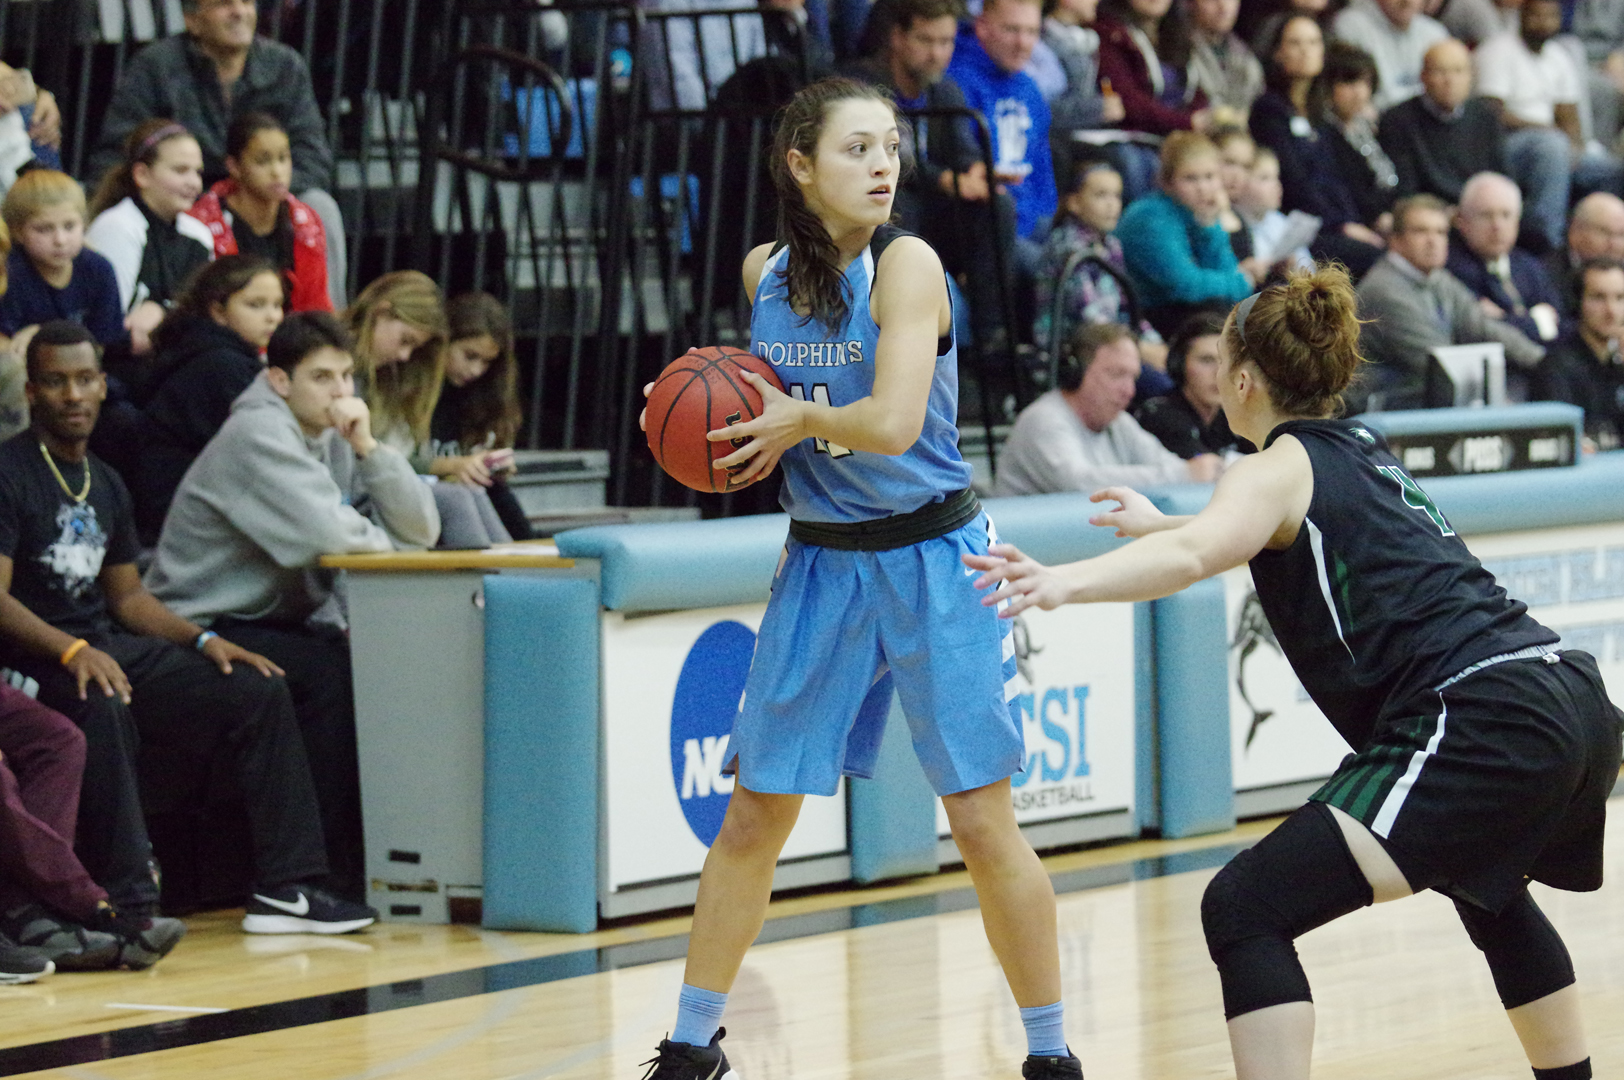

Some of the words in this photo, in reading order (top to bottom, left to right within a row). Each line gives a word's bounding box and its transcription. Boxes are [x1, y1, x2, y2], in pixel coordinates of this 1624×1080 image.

[758, 340, 863, 367] DOLPHINS
[681, 733, 736, 800] NC
[1012, 783, 1096, 812] ASKETBALL
